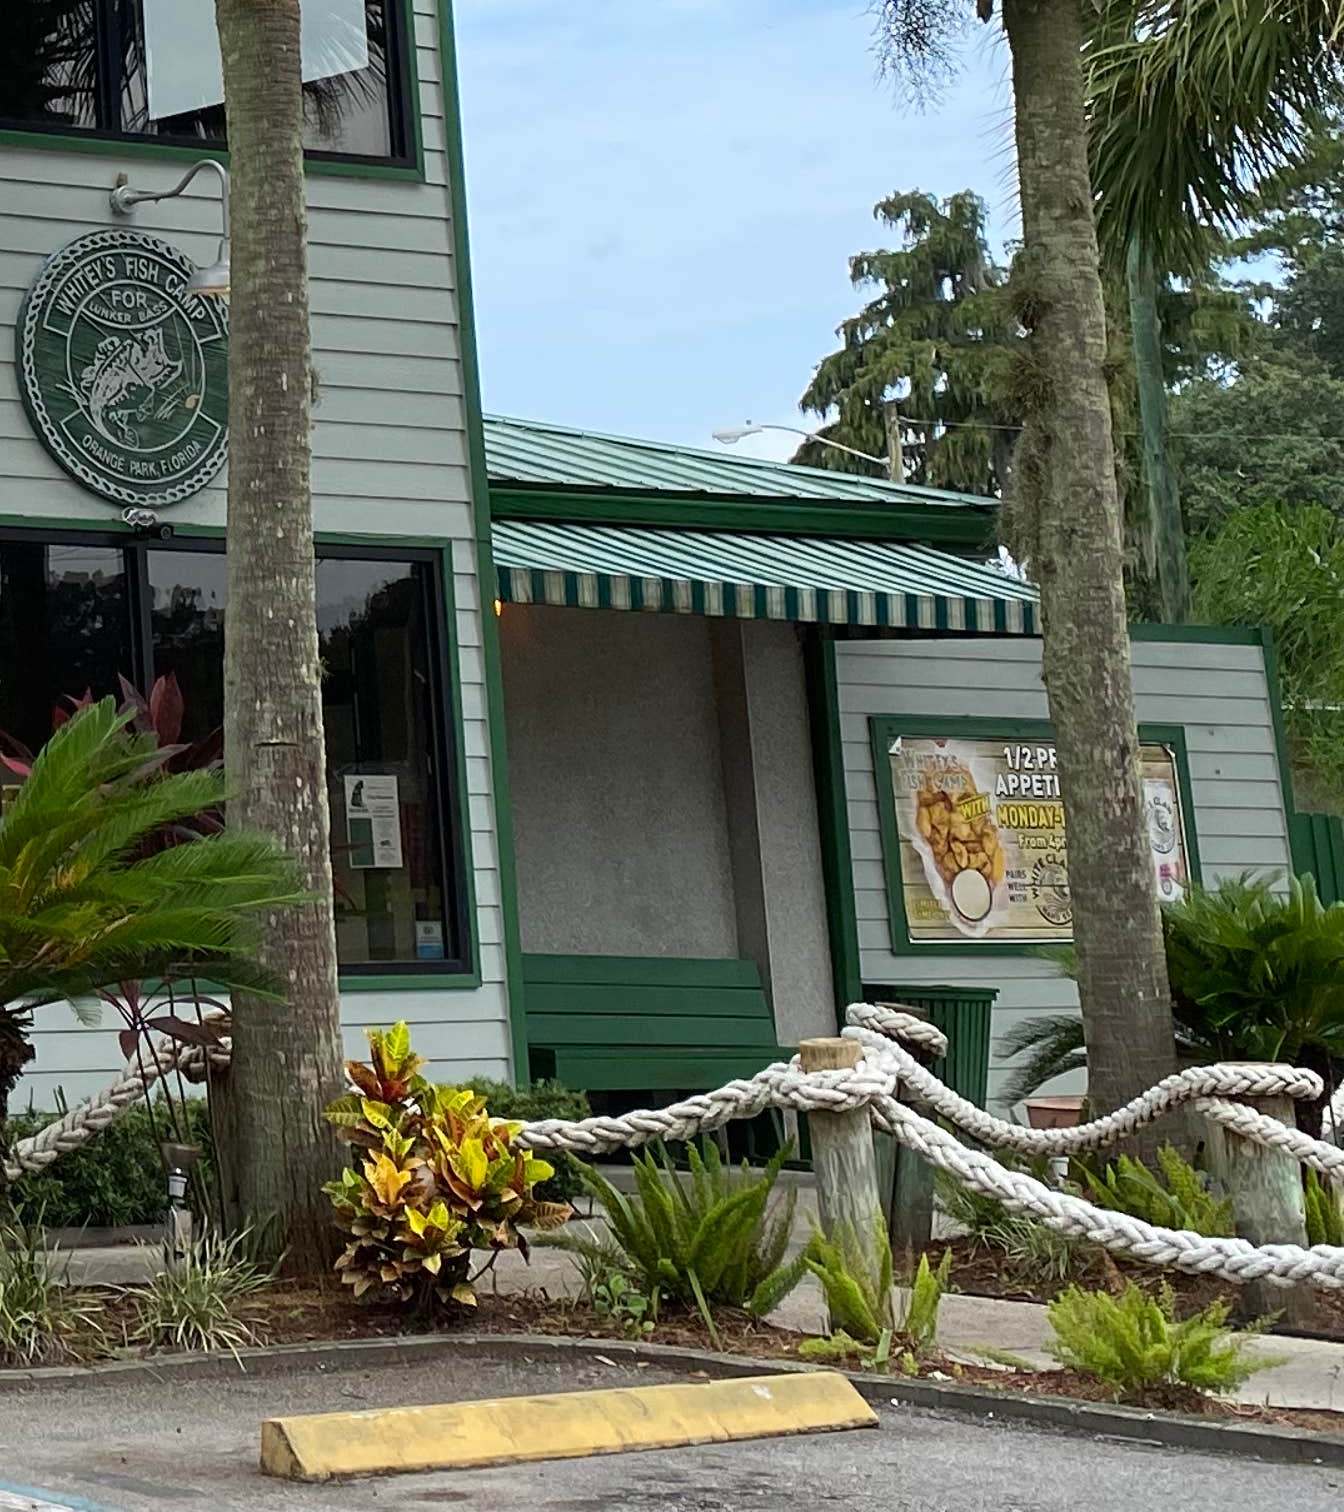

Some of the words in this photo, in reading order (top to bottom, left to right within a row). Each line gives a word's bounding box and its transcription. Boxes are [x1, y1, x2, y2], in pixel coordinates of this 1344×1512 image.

[56, 256, 116, 316] WHITEY'S
[126, 257, 159, 283] FISH
[165, 274, 207, 320] CAMP
[111, 291, 147, 308] FOR
[89, 302, 132, 323] LUNKER
[138, 302, 168, 322] BASS
[82, 434, 126, 472] ORANGE
[129, 460, 161, 477] PARK,
[160, 440, 202, 474] FLORIDA
[1018, 834, 1047, 849] From
[1031, 857, 1045, 900] WHITE
